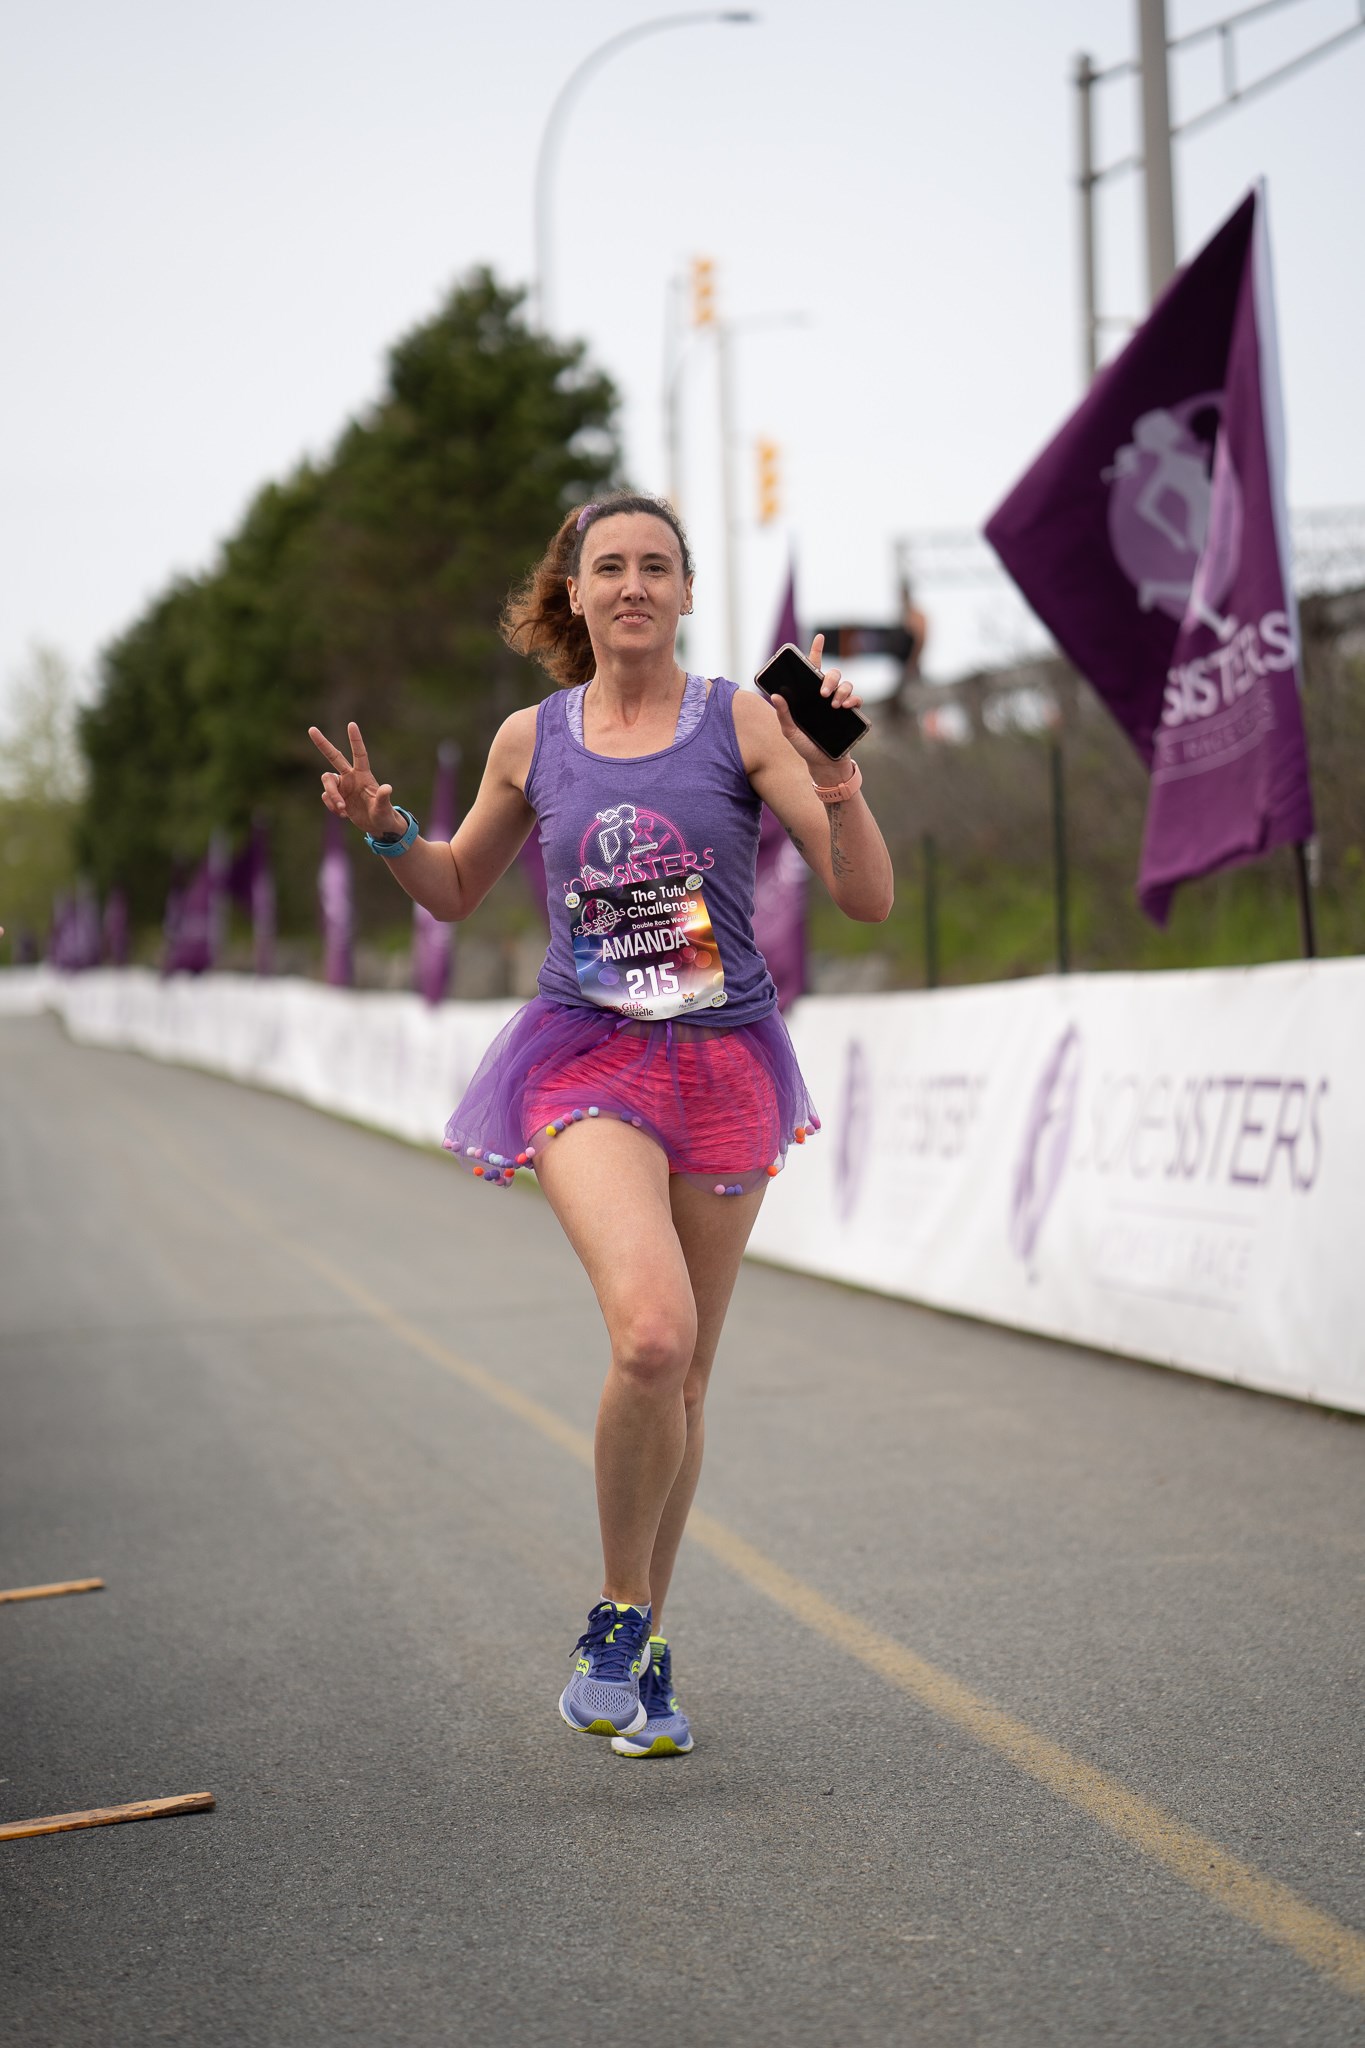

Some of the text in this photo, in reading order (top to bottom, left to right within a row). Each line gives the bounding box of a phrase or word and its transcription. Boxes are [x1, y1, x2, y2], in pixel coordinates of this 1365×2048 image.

[613, 847, 715, 884] SISTERS
[631, 885, 686, 903] The Tutu
[592, 908, 626, 927] SISTERS
[627, 900, 698, 918] Challenge
[632, 921, 654, 930] Double
[602, 926, 690, 963] AMANDA
[626, 962, 680, 999] 215
[621, 1001, 644, 1011] Girls
